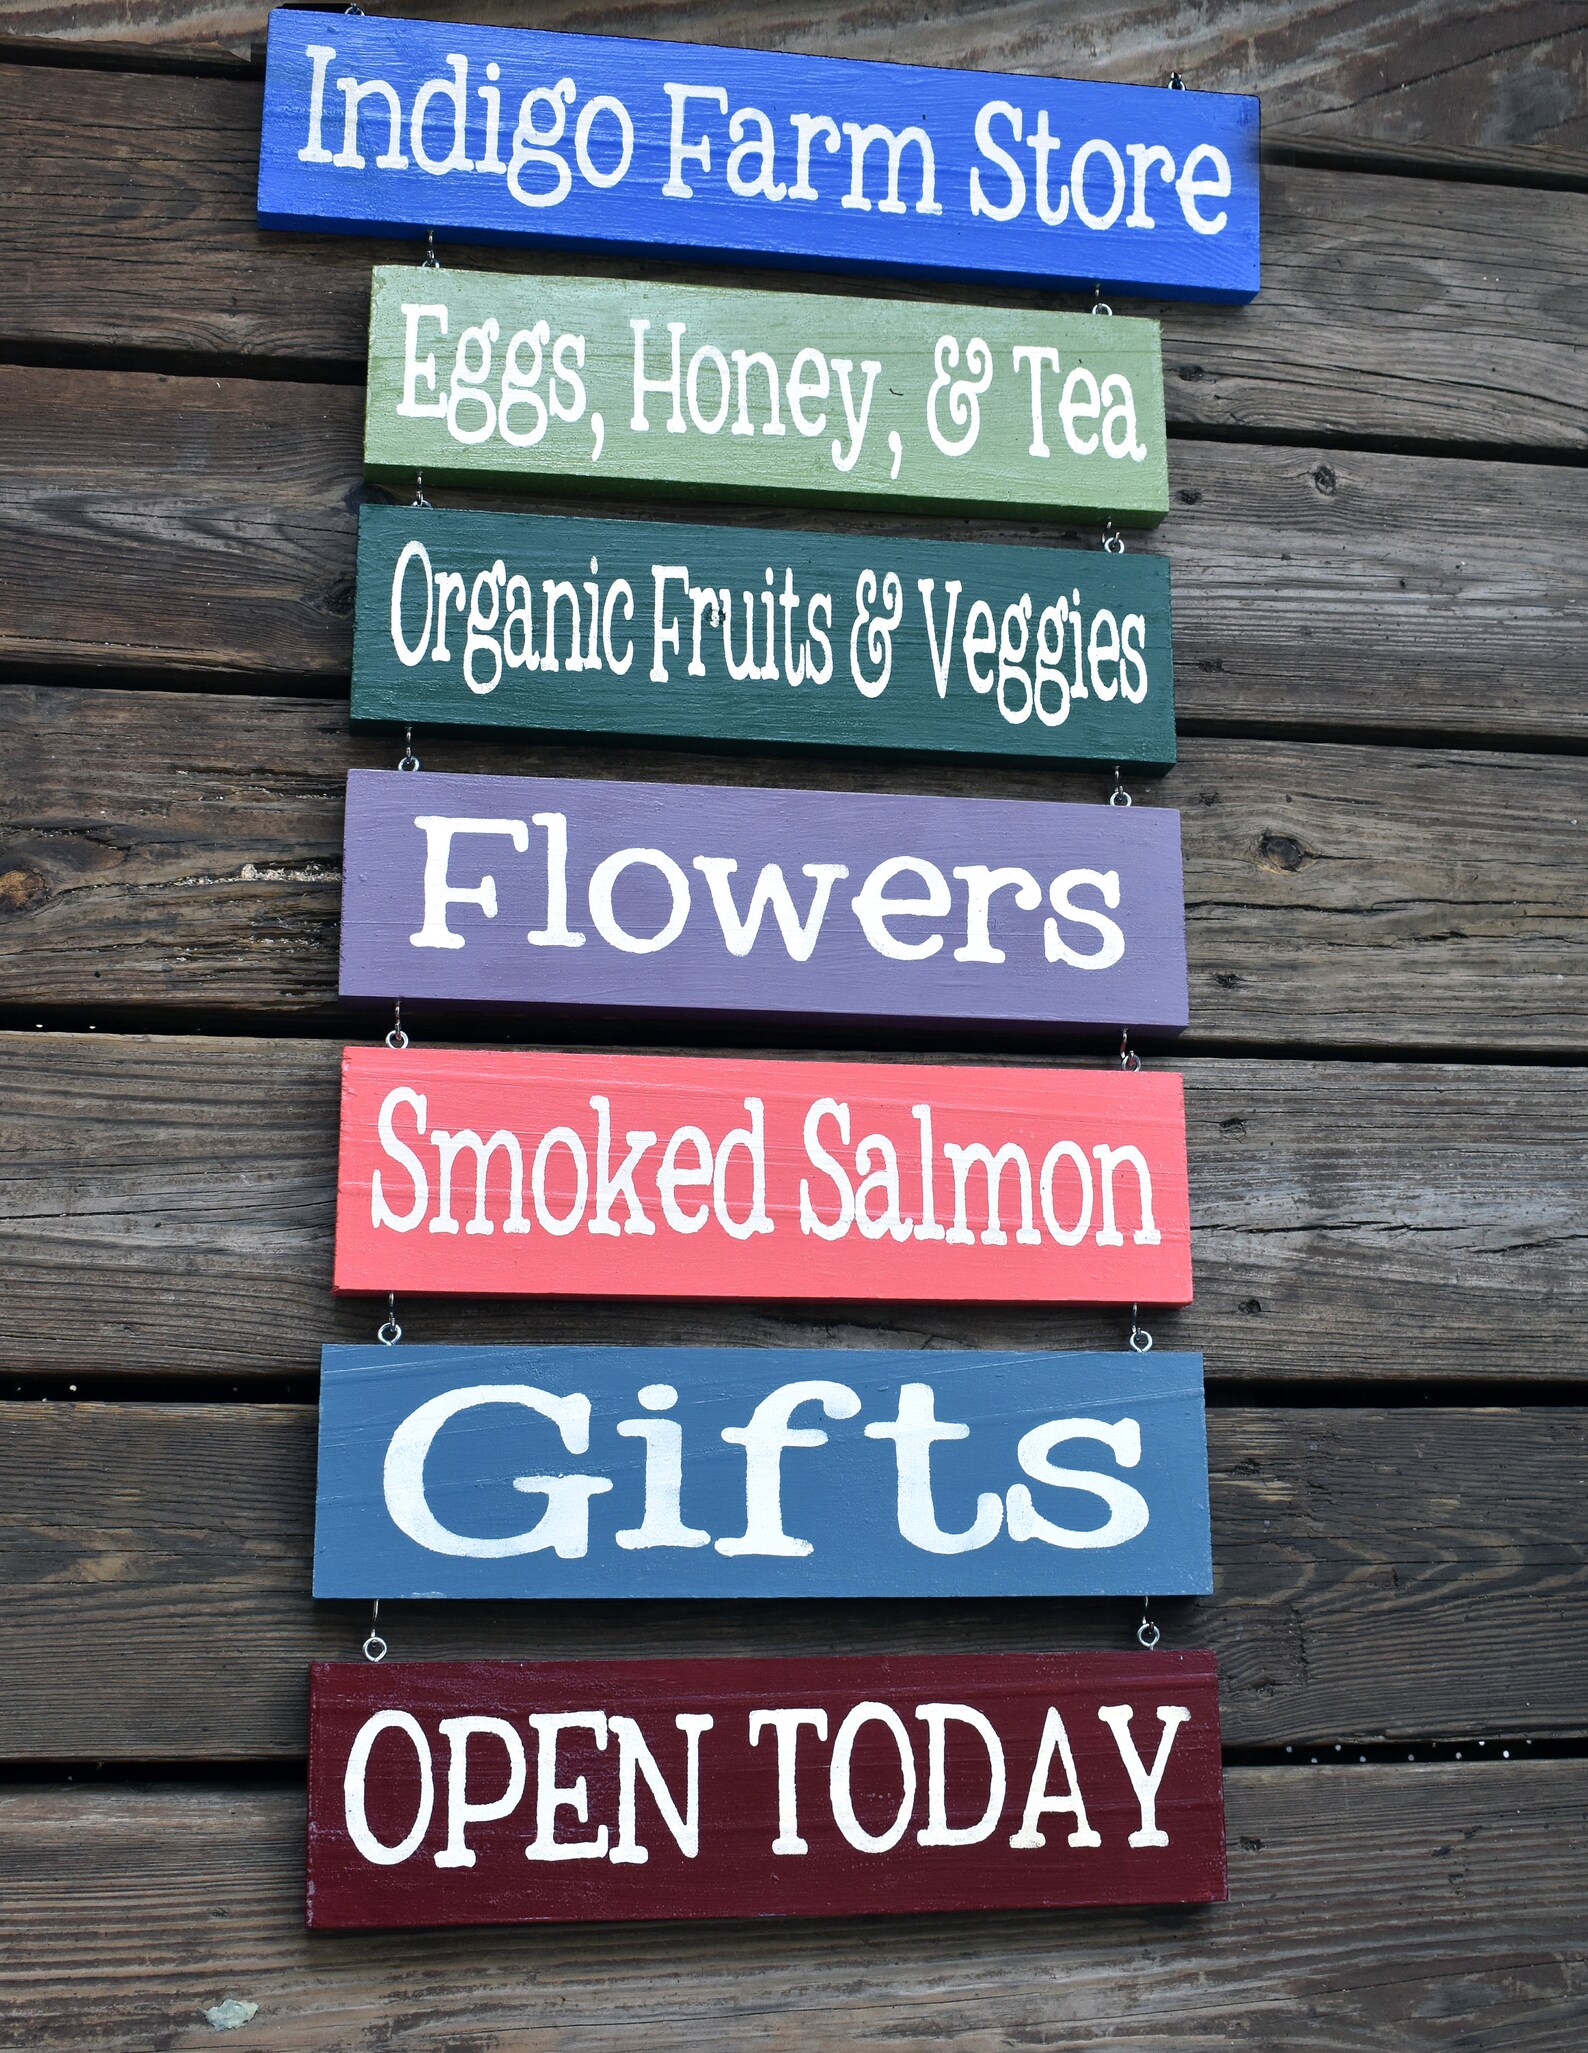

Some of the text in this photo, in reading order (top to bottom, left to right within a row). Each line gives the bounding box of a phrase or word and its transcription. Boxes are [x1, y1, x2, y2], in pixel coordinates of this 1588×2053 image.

[298, 45, 1231, 234] Indigo Farm Store
[396, 303, 1147, 479] Eggs, Honey, & Tea
[391, 541, 1147, 726] Organic Fruits & Veggies
[410, 813, 1125, 970] Flowers
[371, 1087, 1162, 1246] Smoked Salmon
[383, 1380, 1149, 1558] Gifts
[344, 1701, 1191, 1868] OPEN TODAY
